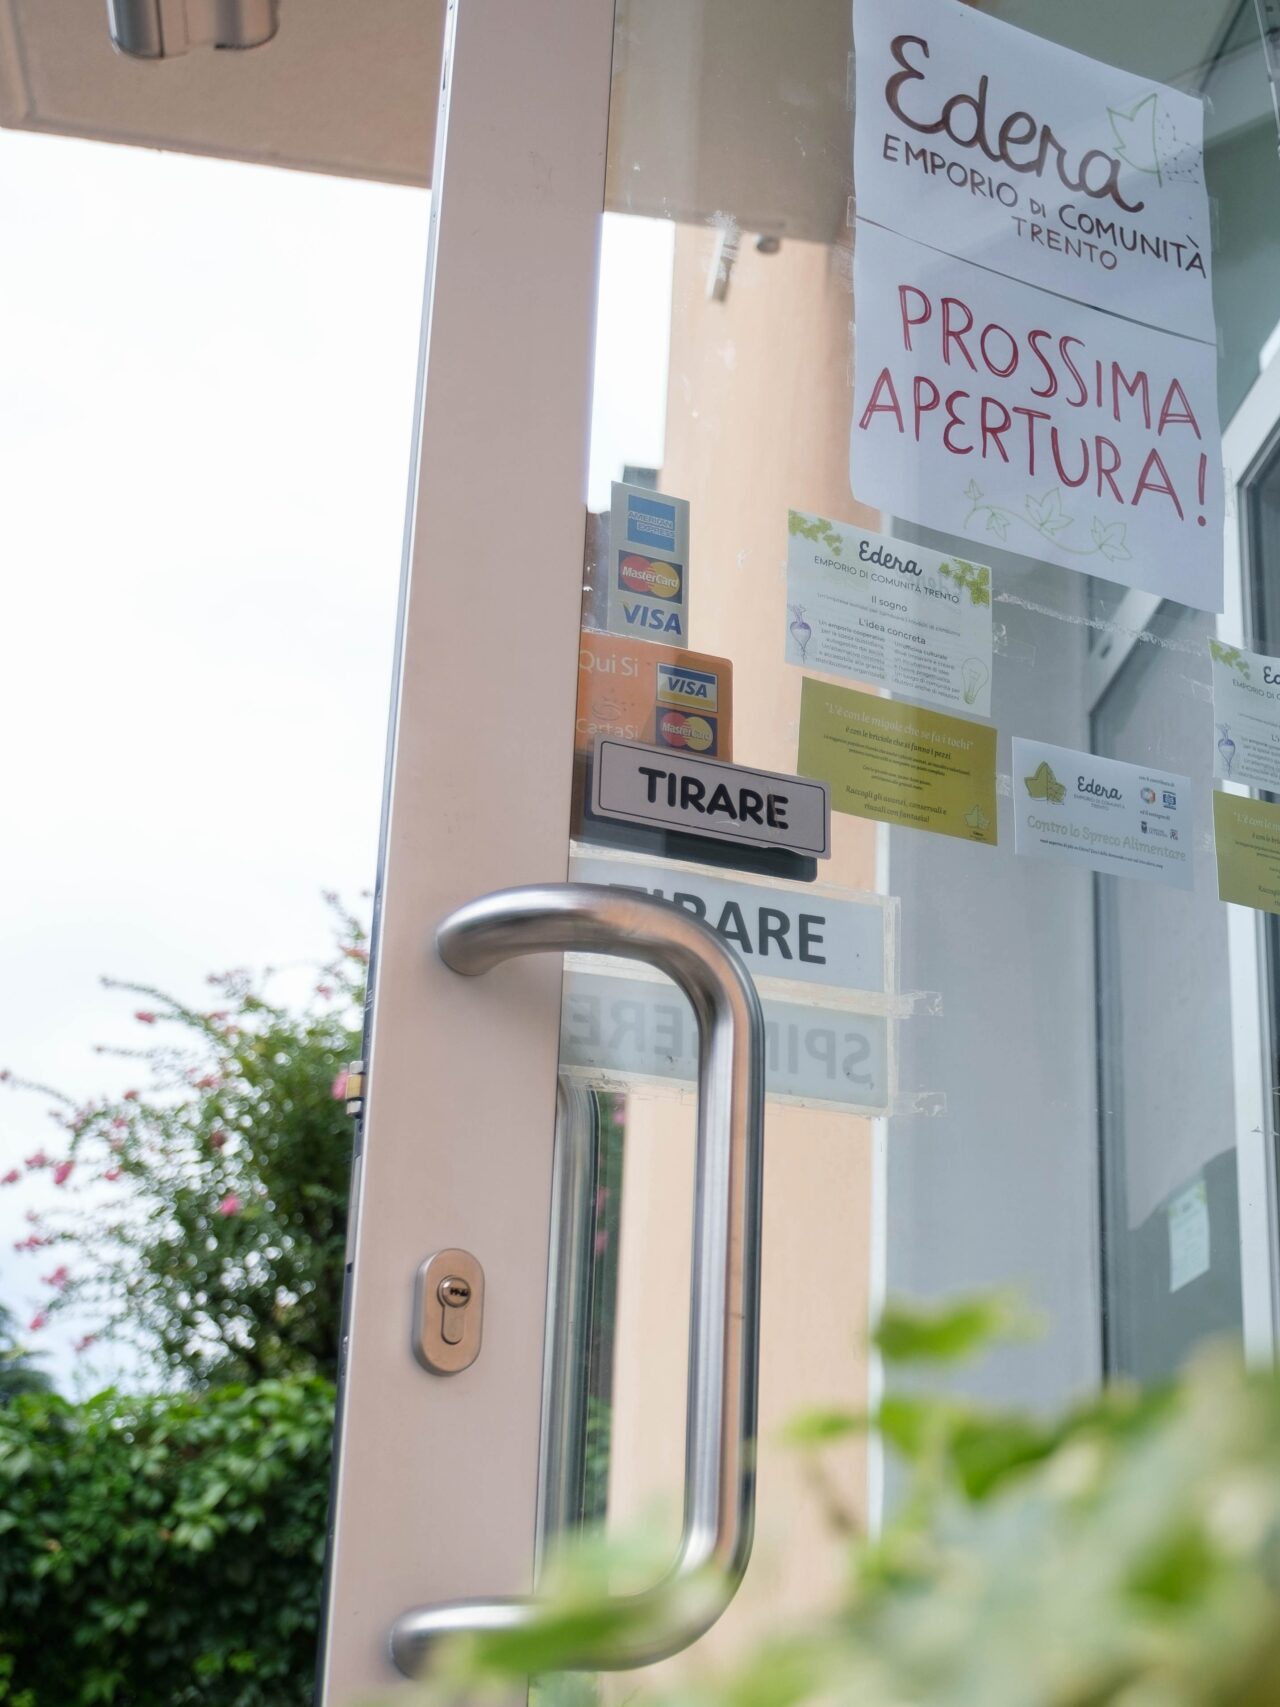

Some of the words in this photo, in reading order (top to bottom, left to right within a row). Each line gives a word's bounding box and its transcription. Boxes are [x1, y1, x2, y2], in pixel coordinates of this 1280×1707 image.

[885, 35, 1144, 212] Edera
[883, 133, 1018, 208] EMPORIO
[1029, 197, 1046, 218] DI
[1059, 204, 1207, 279] COMUNITÀ
[1011, 216, 1117, 270] TRENTO
[898, 285, 1202, 440] PROSSIMA
[628, 511, 673, 530] AMERICAN
[859, 540, 922, 576] Edera
[622, 566, 678, 588] MasterCard
[814, 555, 857, 576] EMPORIO
[859, 569, 869, 580] DI
[871, 572, 921, 593] COMUNITÀ
[923, 586, 960, 603] TRENTO
[623, 602, 682, 635] VISA
[871, 595, 877, 604] Il
[879, 598, 908, 613] sogno
[887, 627, 926, 645] concreta
[579, 651, 616, 674] Qui
[621, 656, 639, 677] Si
[667, 677, 708, 699] VISA
[661, 721, 711, 742] MasterCard
[638, 766, 789, 830] TIRARE
[1077, 774, 1122, 801] Edera
[1027, 814, 1066, 837] Contro
[1070, 823, 1079, 837] lo
[1081, 825, 1120, 850] Spreco
[1122, 833, 1185, 862] Alimentare
[609, 883, 826, 965] ARE
